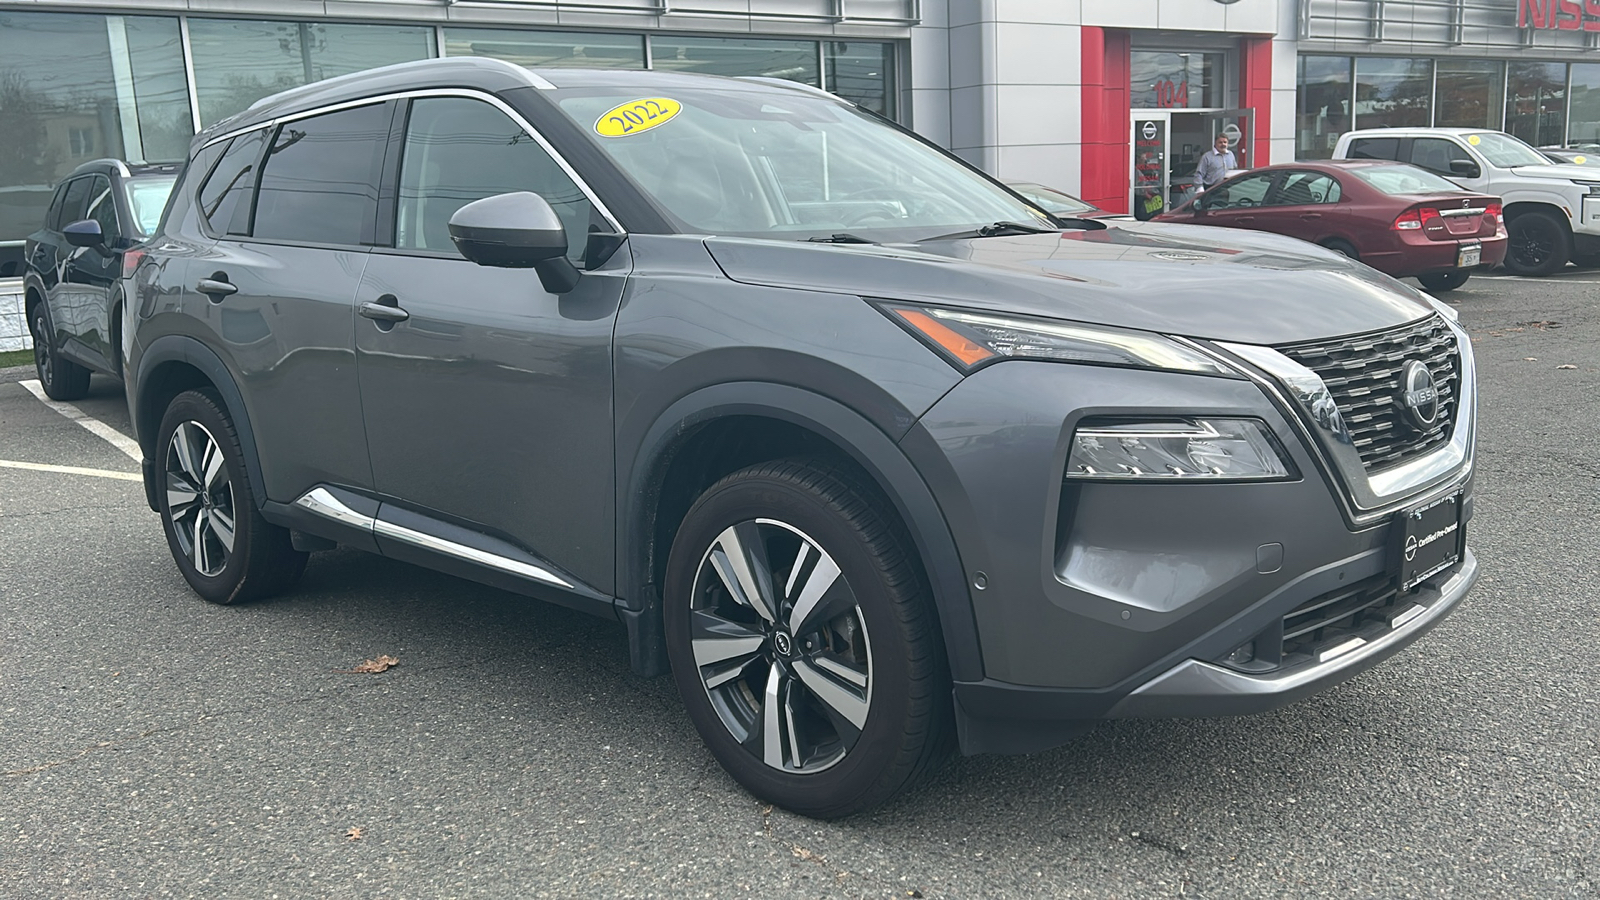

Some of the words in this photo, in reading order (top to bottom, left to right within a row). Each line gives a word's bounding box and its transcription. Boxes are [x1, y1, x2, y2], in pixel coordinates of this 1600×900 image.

[1153, 80, 1188, 108] 104
[609, 100, 669, 133] 2022
[1418, 532, 1437, 548] Certified
[1436, 521, 1458, 539] Pre-Owned
